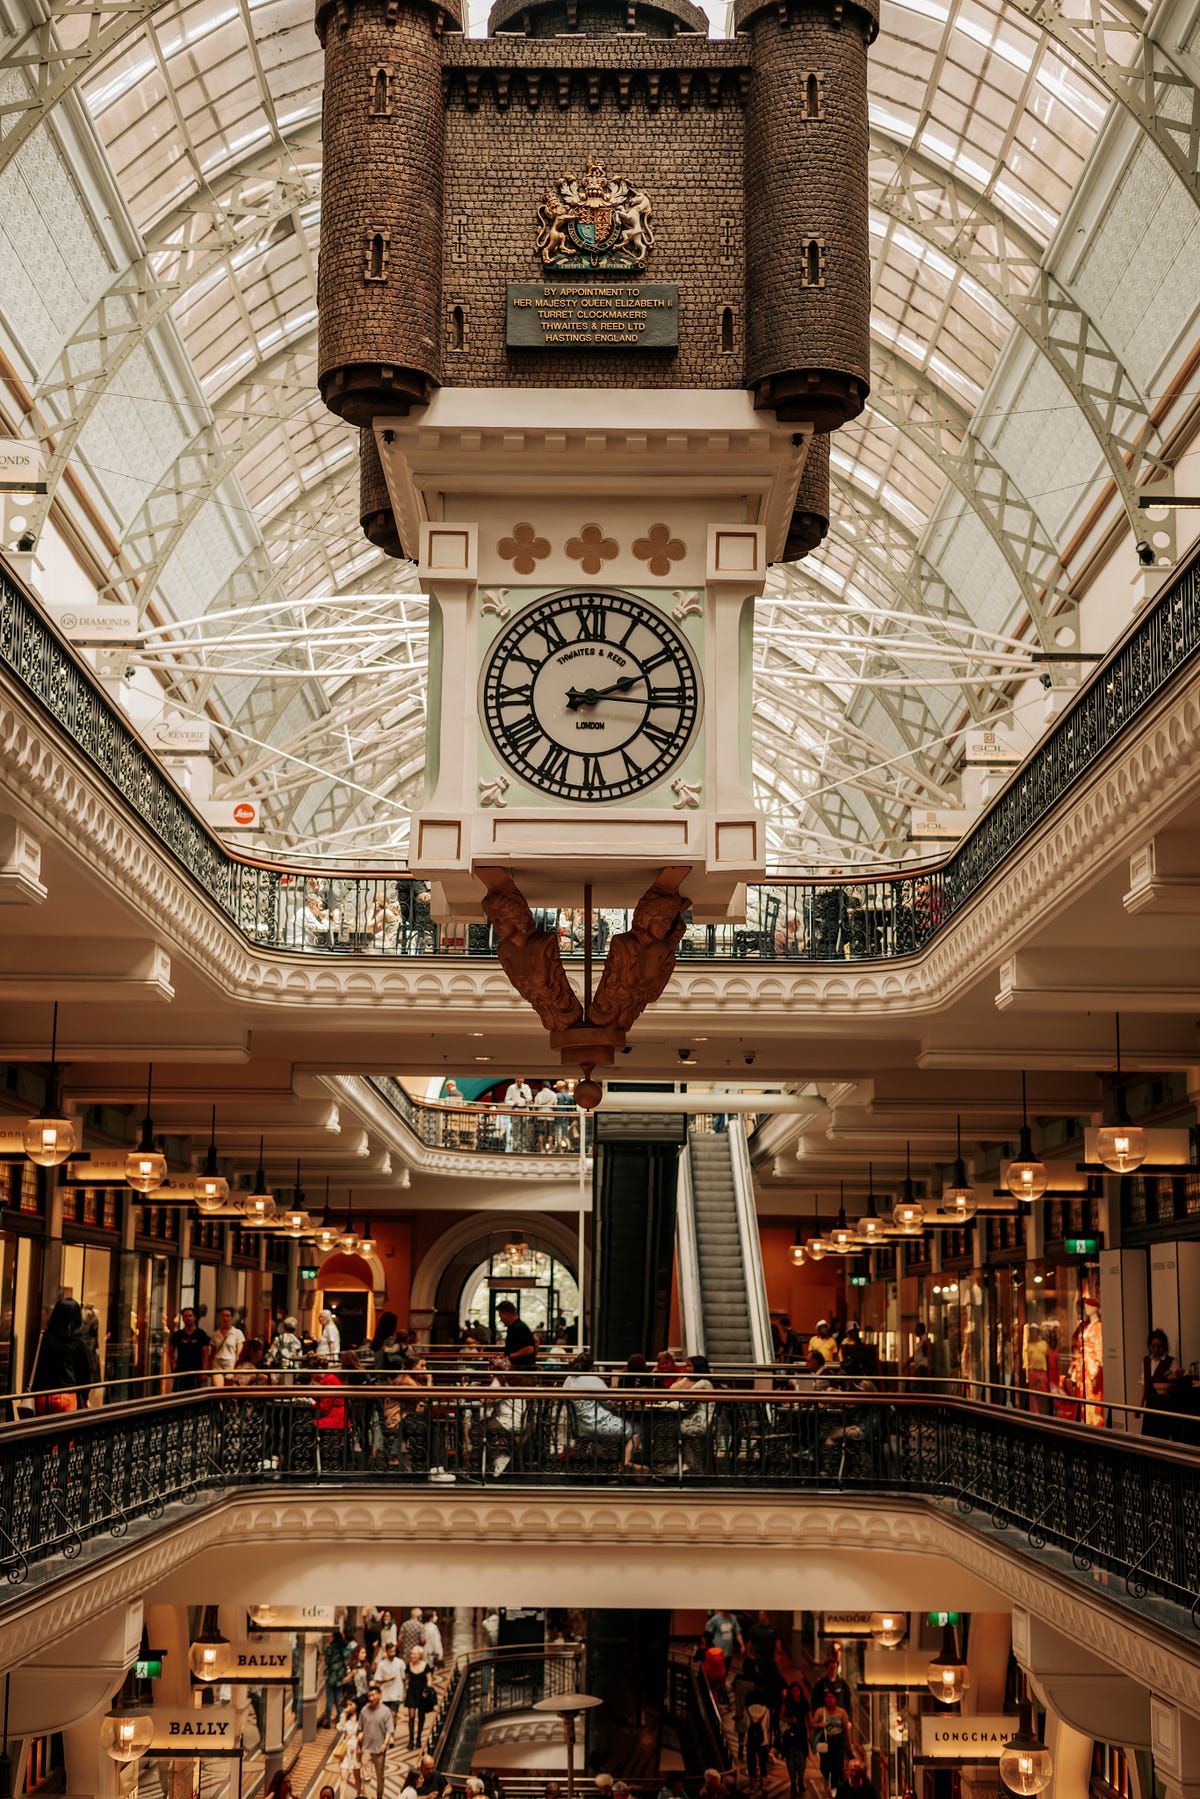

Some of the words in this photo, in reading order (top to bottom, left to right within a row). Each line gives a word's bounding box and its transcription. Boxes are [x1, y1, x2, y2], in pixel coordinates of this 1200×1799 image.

[544, 288, 557, 297] BY
[560, 288, 624, 297] APPOINTMENT
[627, 288, 640, 297] TO
[513, 299, 532, 308] HER
[535, 299, 578, 308] MAJESTY
[581, 299, 613, 308] QUEEN
[615, 299, 665, 308] ELIZABETH
[667, 299, 673, 308] II
[538, 310, 574, 319] TURRET
[577, 310, 648, 319] CLOCKMAKERS
[541, 322, 588, 331] THWAITES
[591, 322, 597, 331] &
[600, 322, 625, 331] REED
[628, 322, 646, 331] LTD
[545, 334, 592, 343] HASTINGS
[595, 334, 639, 343] ENGLAND
[79, 617, 131, 627] DIAMONDS
[576, 606, 606, 641] XII
[533, 617, 567, 654] XI
[510, 645, 541, 675] X
[556, 647, 596, 667] THWAITES
[598, 648, 605, 657] &
[606, 651, 627, 668] REED
[642, 646, 674, 675] II
[575, 721, 605, 730] LONDON
[971, 744, 1008, 752] SOL
[916, 822, 946, 830] SOL
[237, 1655, 288, 1667] BALLY
[169, 1722, 230, 1736] BALLY
